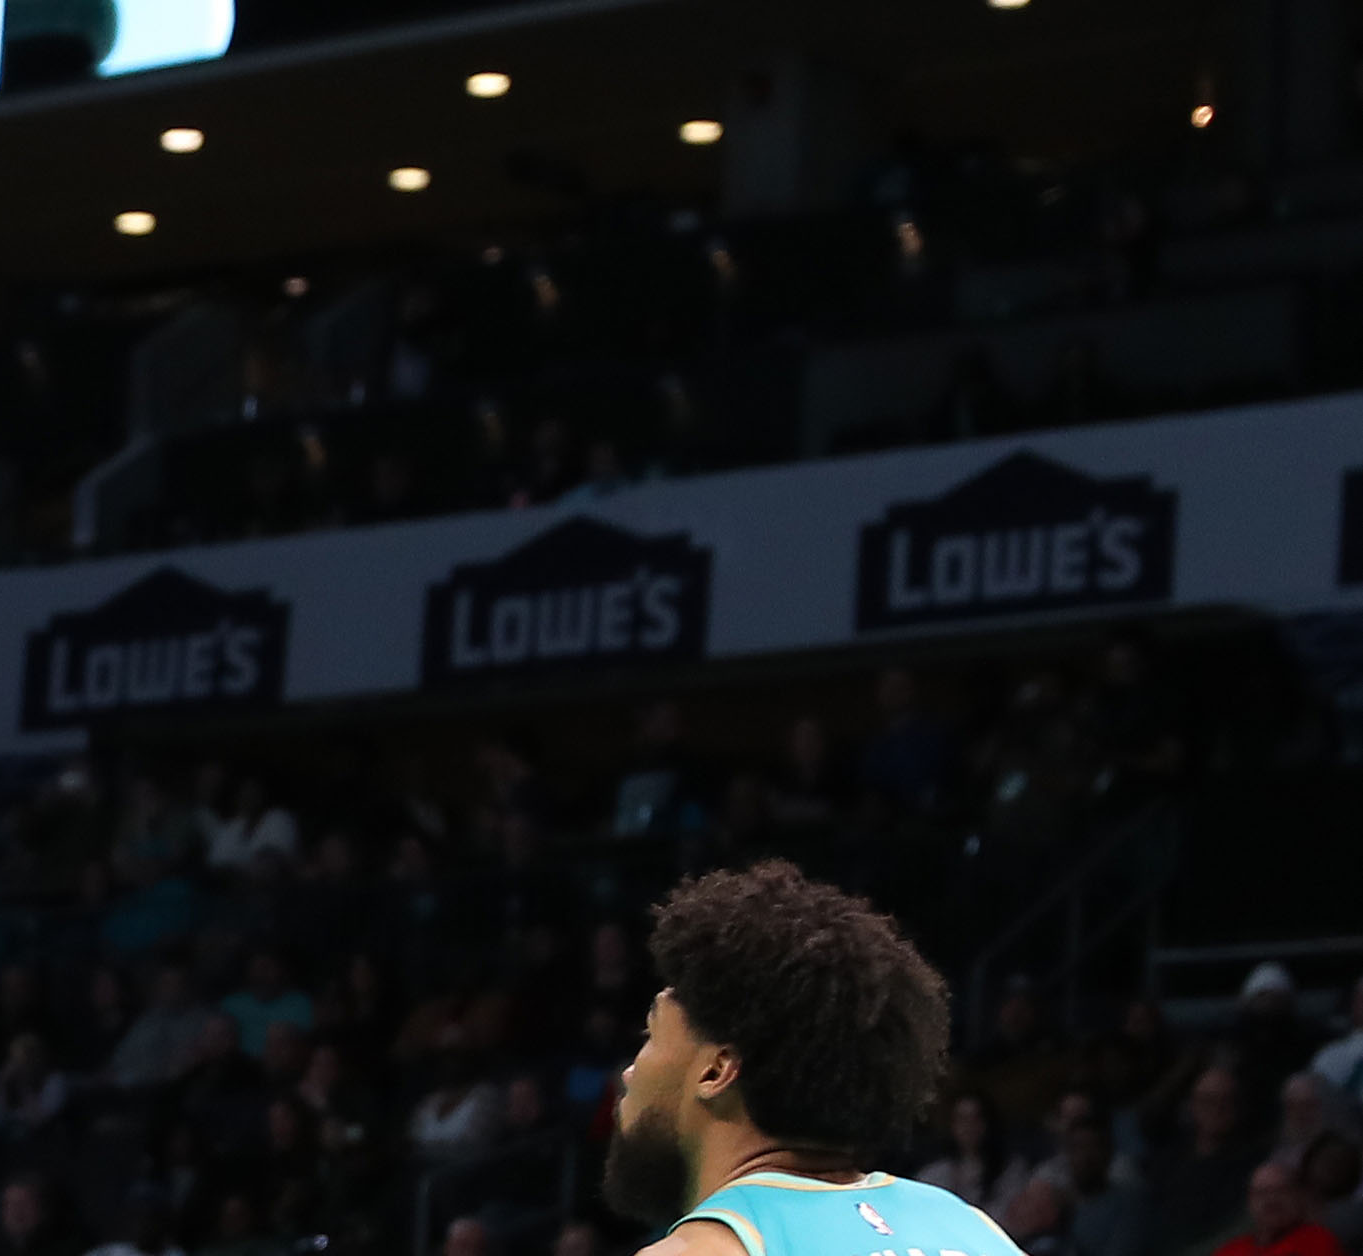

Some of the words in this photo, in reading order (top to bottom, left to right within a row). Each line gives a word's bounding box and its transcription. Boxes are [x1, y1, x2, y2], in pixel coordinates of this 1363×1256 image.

[888, 506, 1144, 609] LOWE'S
[48, 619, 264, 711] LOWE'S
[451, 566, 682, 669] LOWE'S
